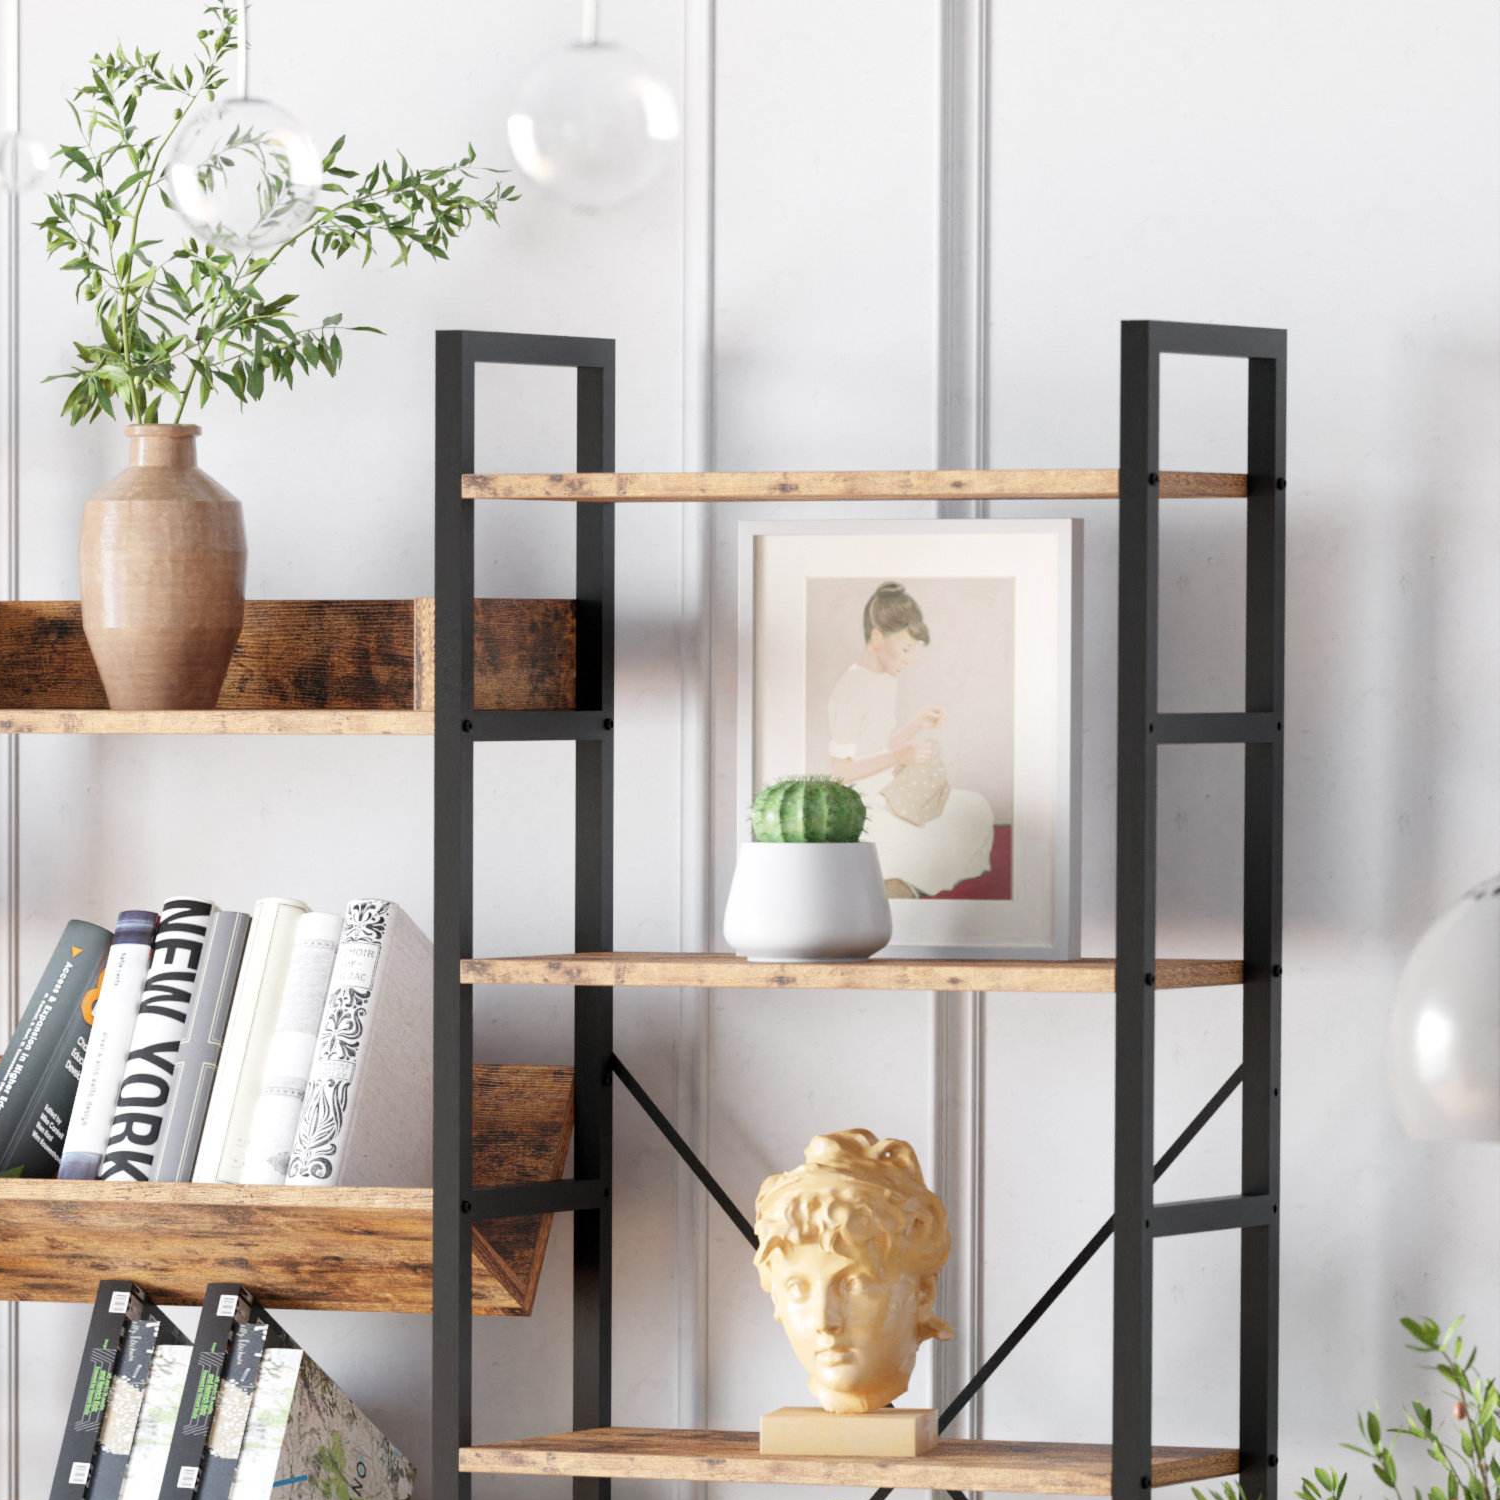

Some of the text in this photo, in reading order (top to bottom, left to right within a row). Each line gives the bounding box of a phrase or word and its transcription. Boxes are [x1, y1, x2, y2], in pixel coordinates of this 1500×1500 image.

[53, 961, 73, 993] Access
[48, 993, 57, 1003] &
[25, 1004, 53, 1051] Expansion
[99, 900, 212, 1182] NEW YORK
[19, 1050, 30, 1062] in
[4, 1062, 24, 1095] Higher
